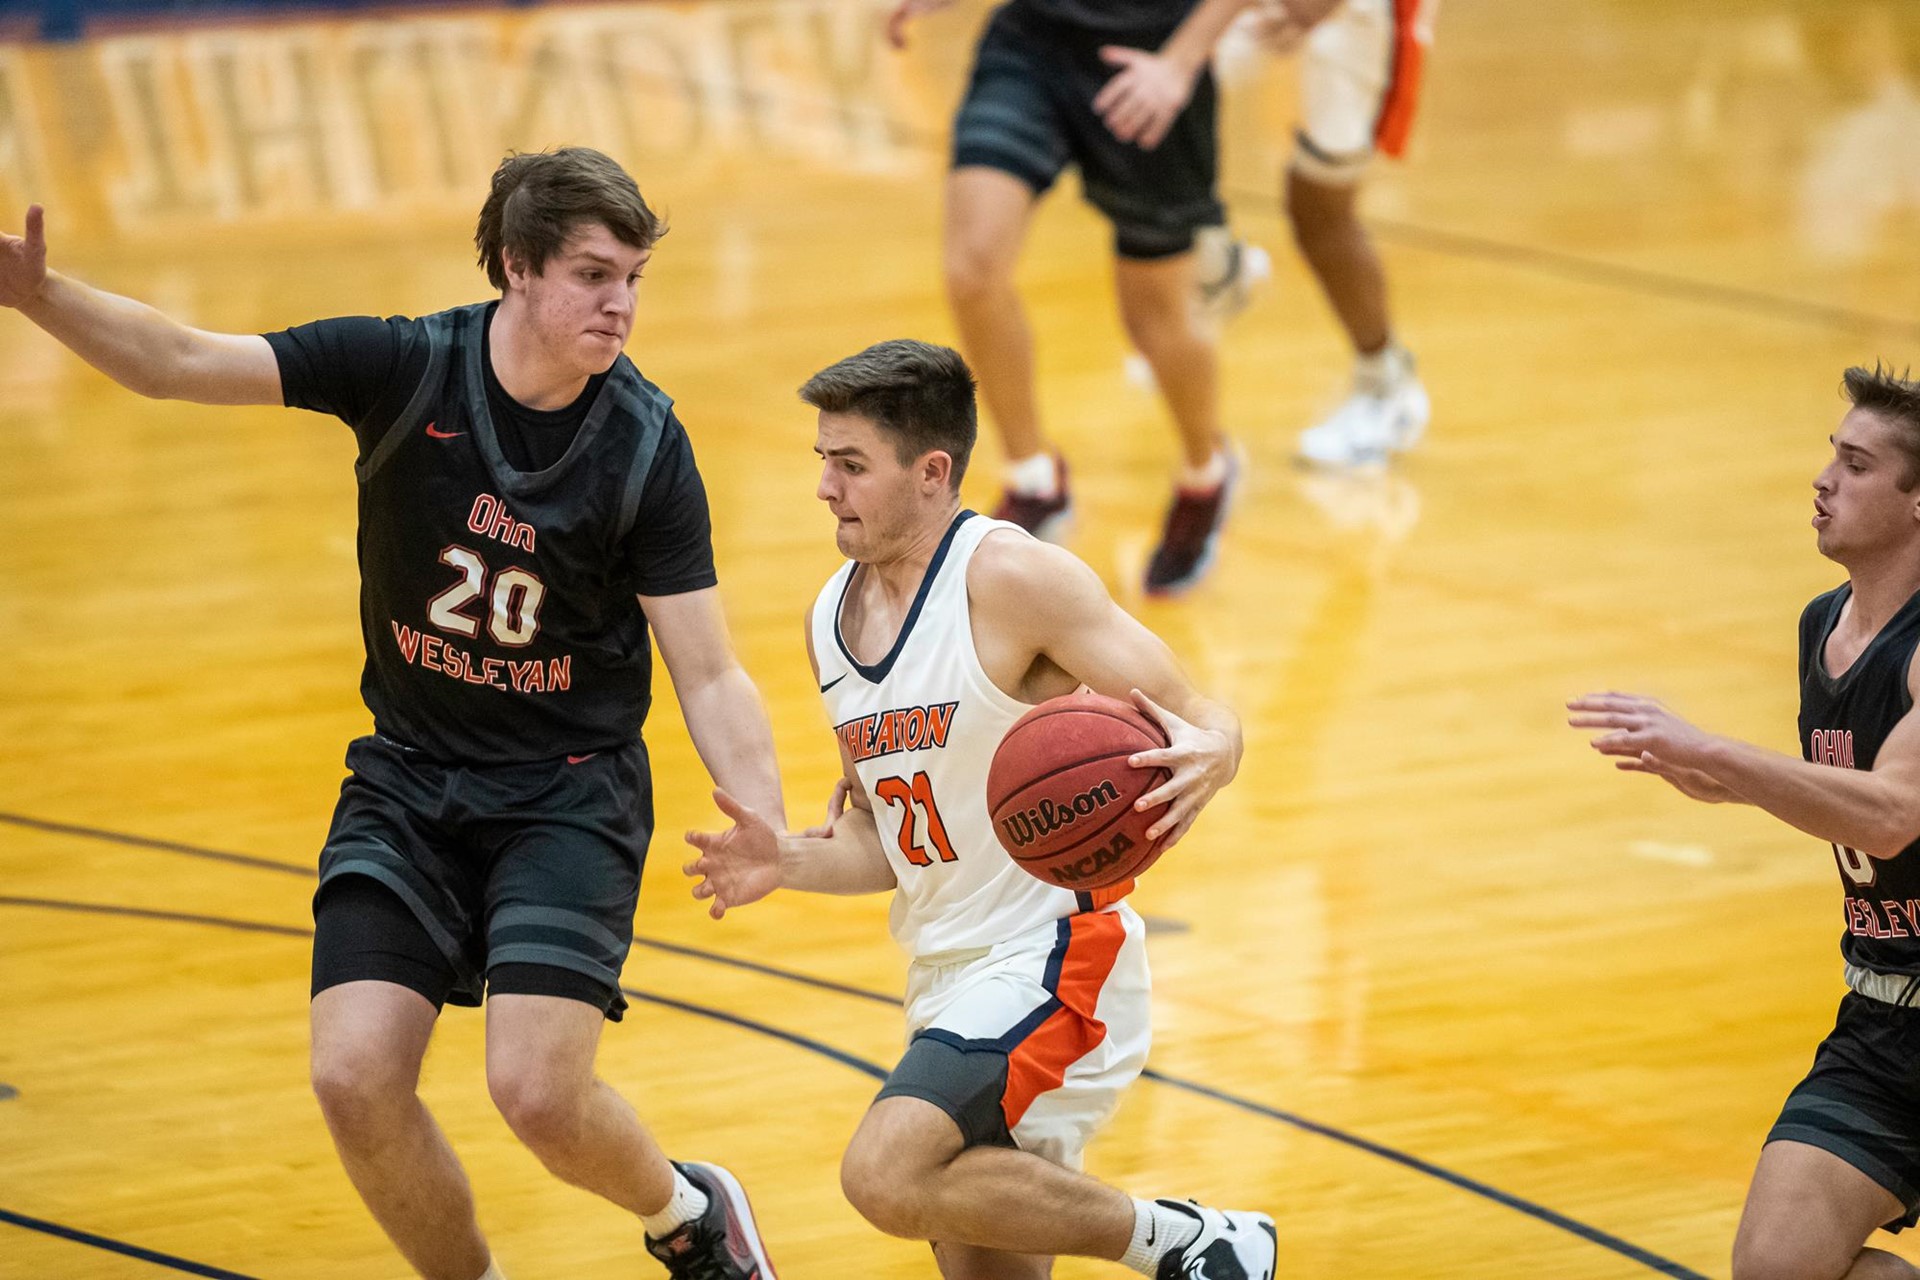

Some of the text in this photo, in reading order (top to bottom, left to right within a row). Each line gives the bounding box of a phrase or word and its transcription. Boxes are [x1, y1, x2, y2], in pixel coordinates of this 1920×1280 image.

[426, 543, 548, 648] 20
[391, 619, 572, 693] WESLEYAN
[1811, 729, 1855, 769] OHIO
[875, 770, 959, 867] 21
[1001, 779, 1122, 848] Wilson
[1049, 831, 1136, 883] NCAA
